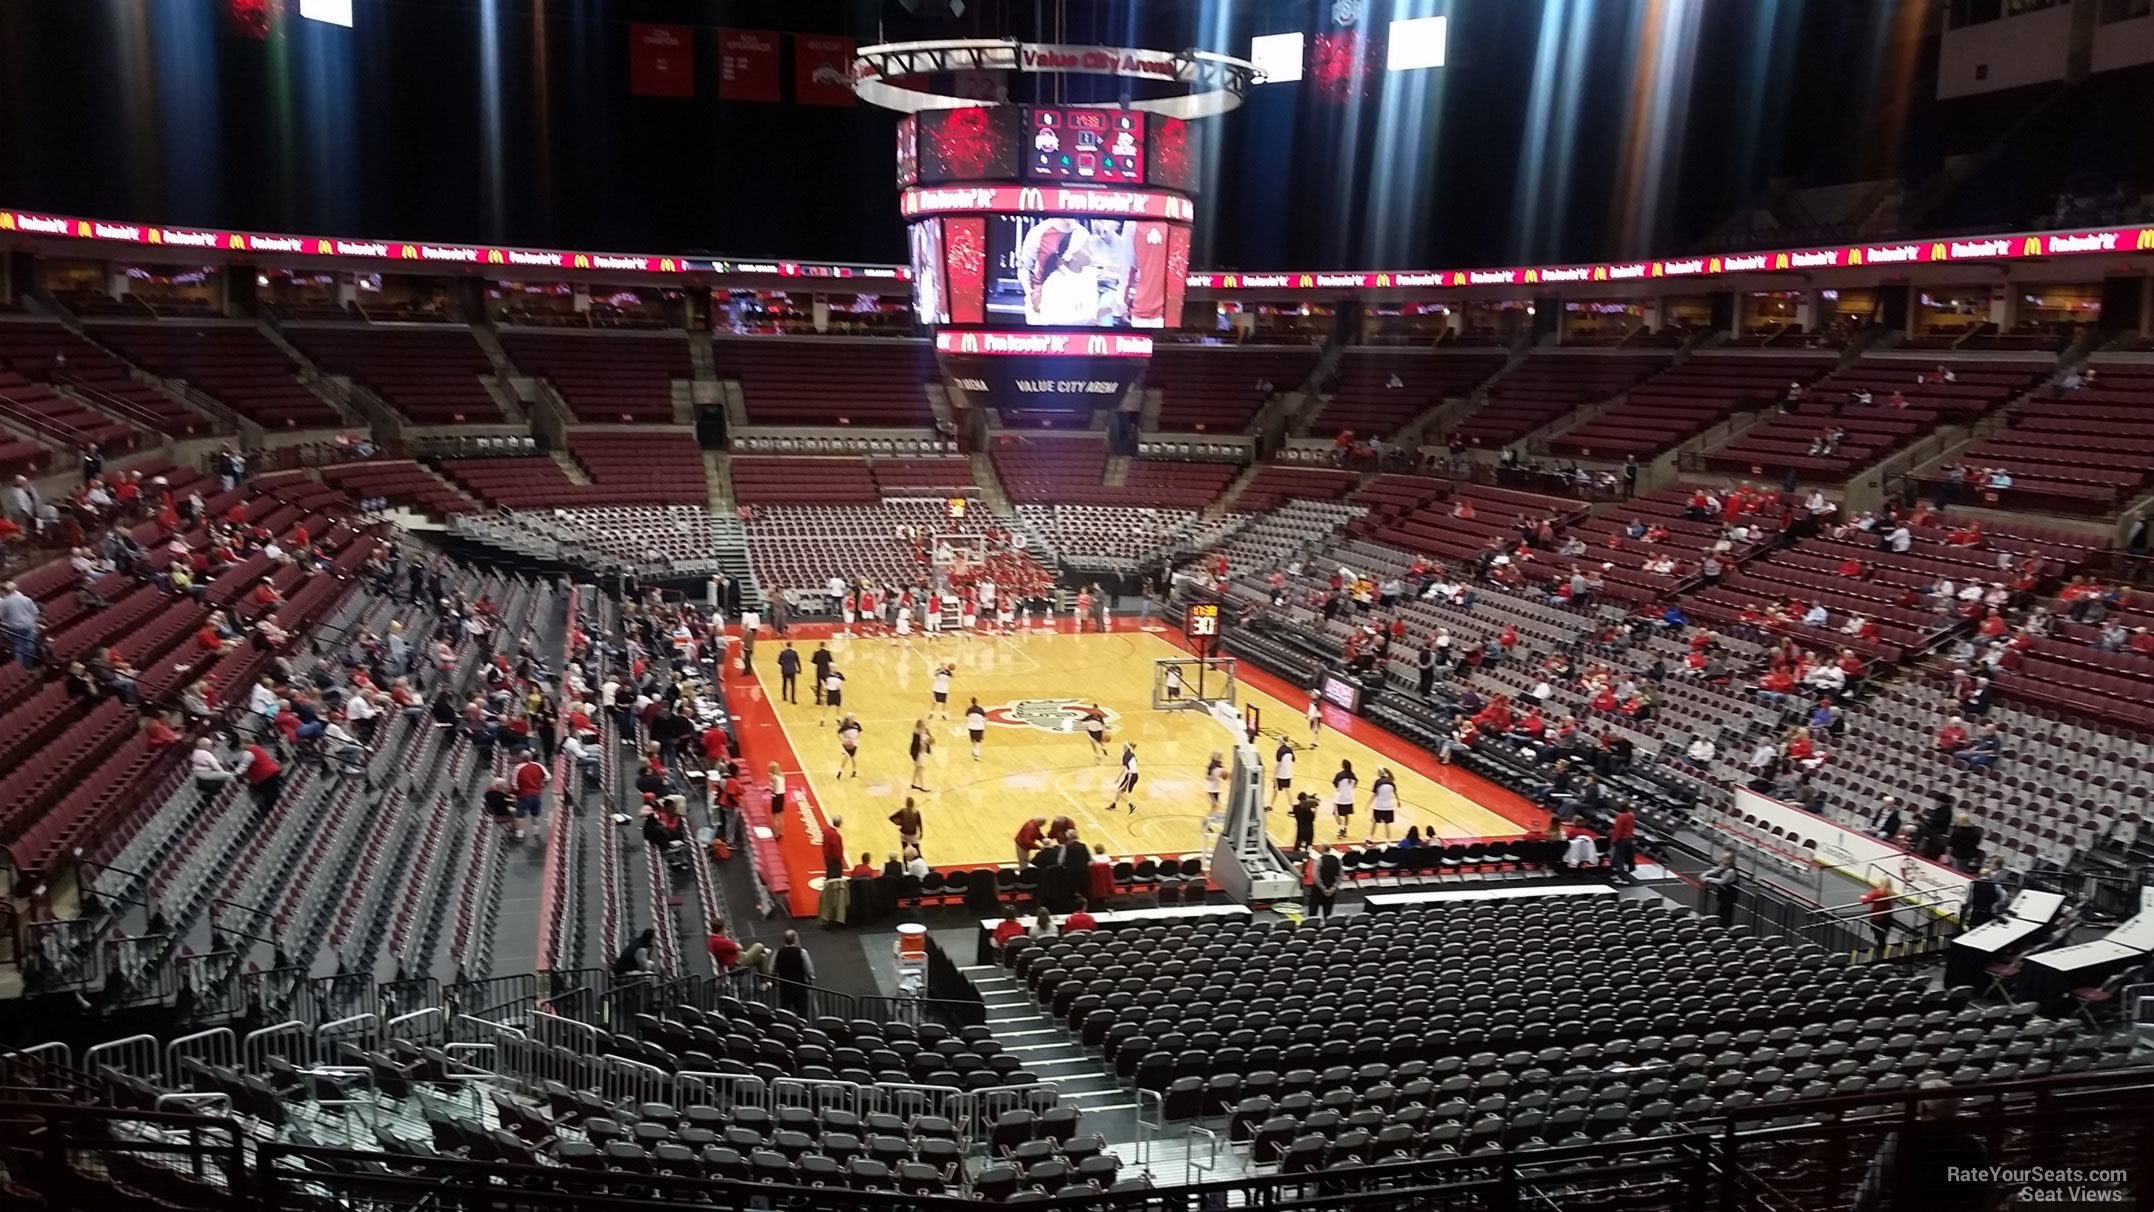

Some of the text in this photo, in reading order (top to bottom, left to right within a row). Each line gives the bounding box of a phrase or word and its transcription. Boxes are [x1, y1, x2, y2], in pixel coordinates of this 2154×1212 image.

[1023, 50, 1078, 67] Value
[1082, 51, 1120, 74] City
[1015, 379, 1120, 394] VALUE CITY ARENA
[1193, 616, 1215, 635] 30
